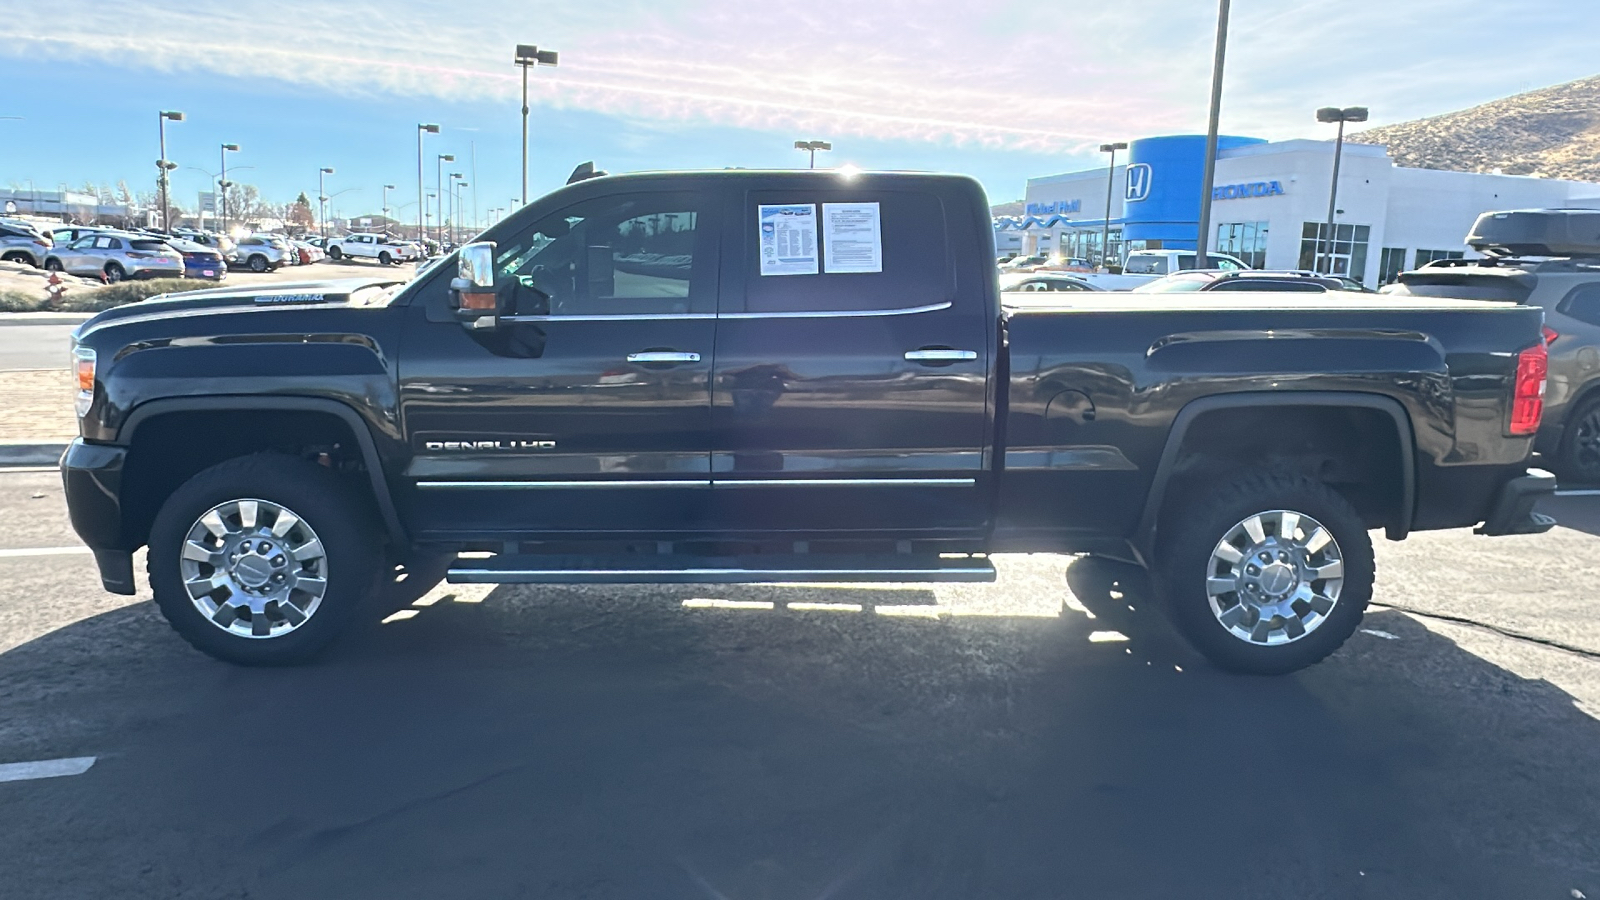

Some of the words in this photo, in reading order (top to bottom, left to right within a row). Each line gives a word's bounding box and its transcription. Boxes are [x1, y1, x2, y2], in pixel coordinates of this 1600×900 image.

[1212, 180, 1284, 200] HONDA
[425, 440, 516, 450] DENALI
[520, 440, 556, 450] HD
